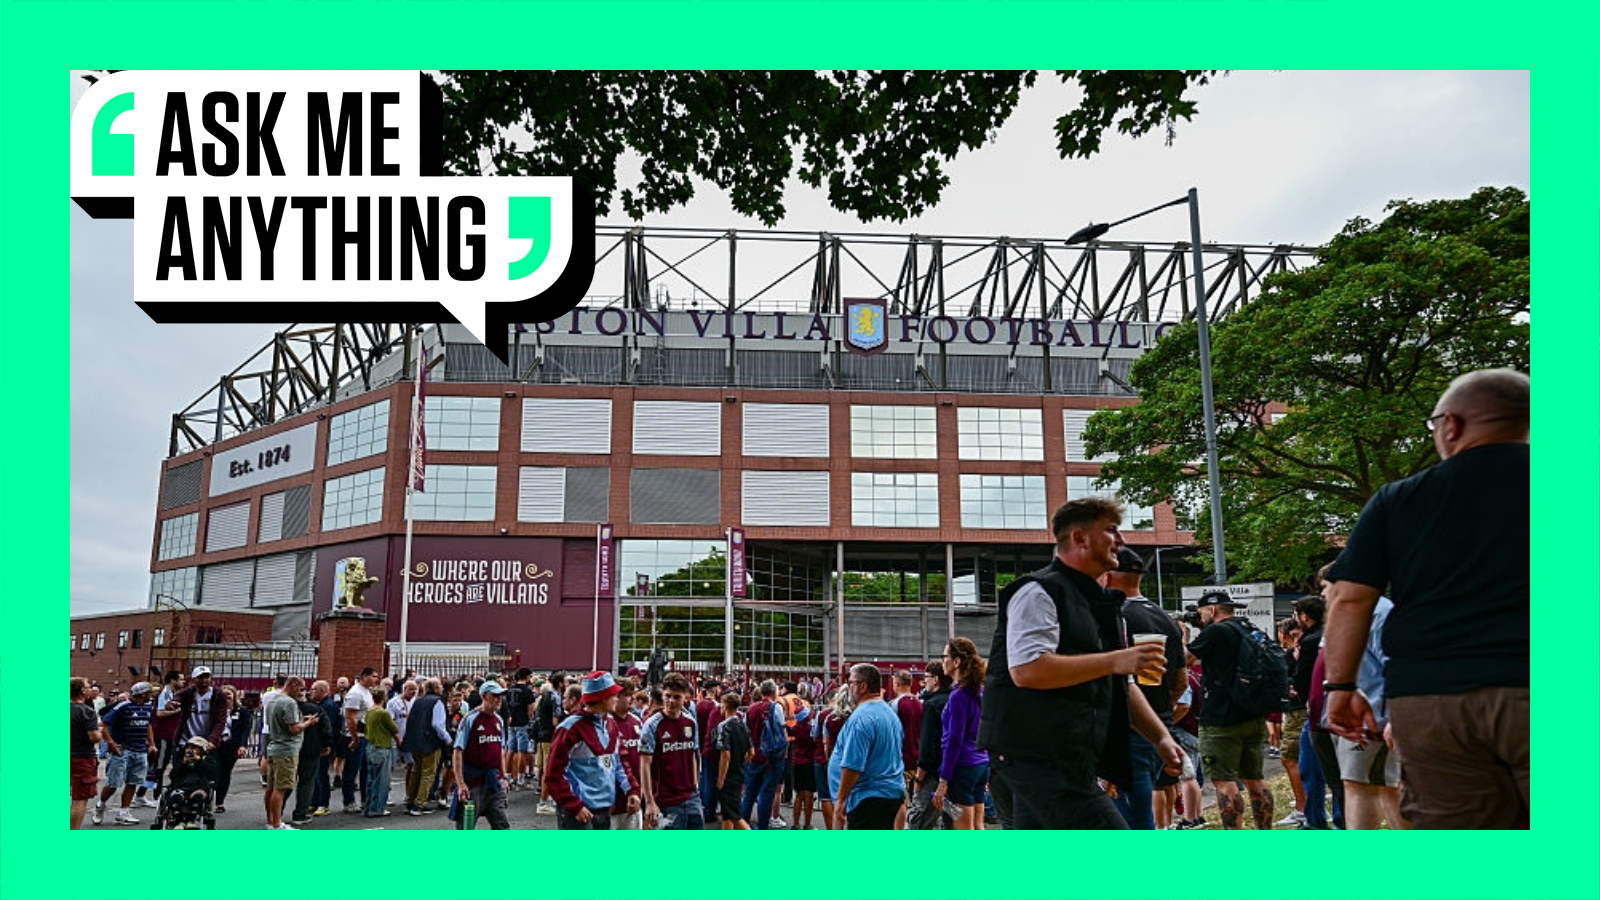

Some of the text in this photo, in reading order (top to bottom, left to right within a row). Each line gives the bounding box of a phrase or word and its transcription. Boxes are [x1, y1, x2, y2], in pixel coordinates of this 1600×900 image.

[515, 305, 665, 336] TON
[687, 310, 832, 341] VILLA
[898, 314, 1141, 348] FOOTBALL
[229, 444, 290, 478] Est. 1874
[432, 560, 522, 582] WHERE OUR
[406, 582, 548, 604] HEROES ARE VILLANS
